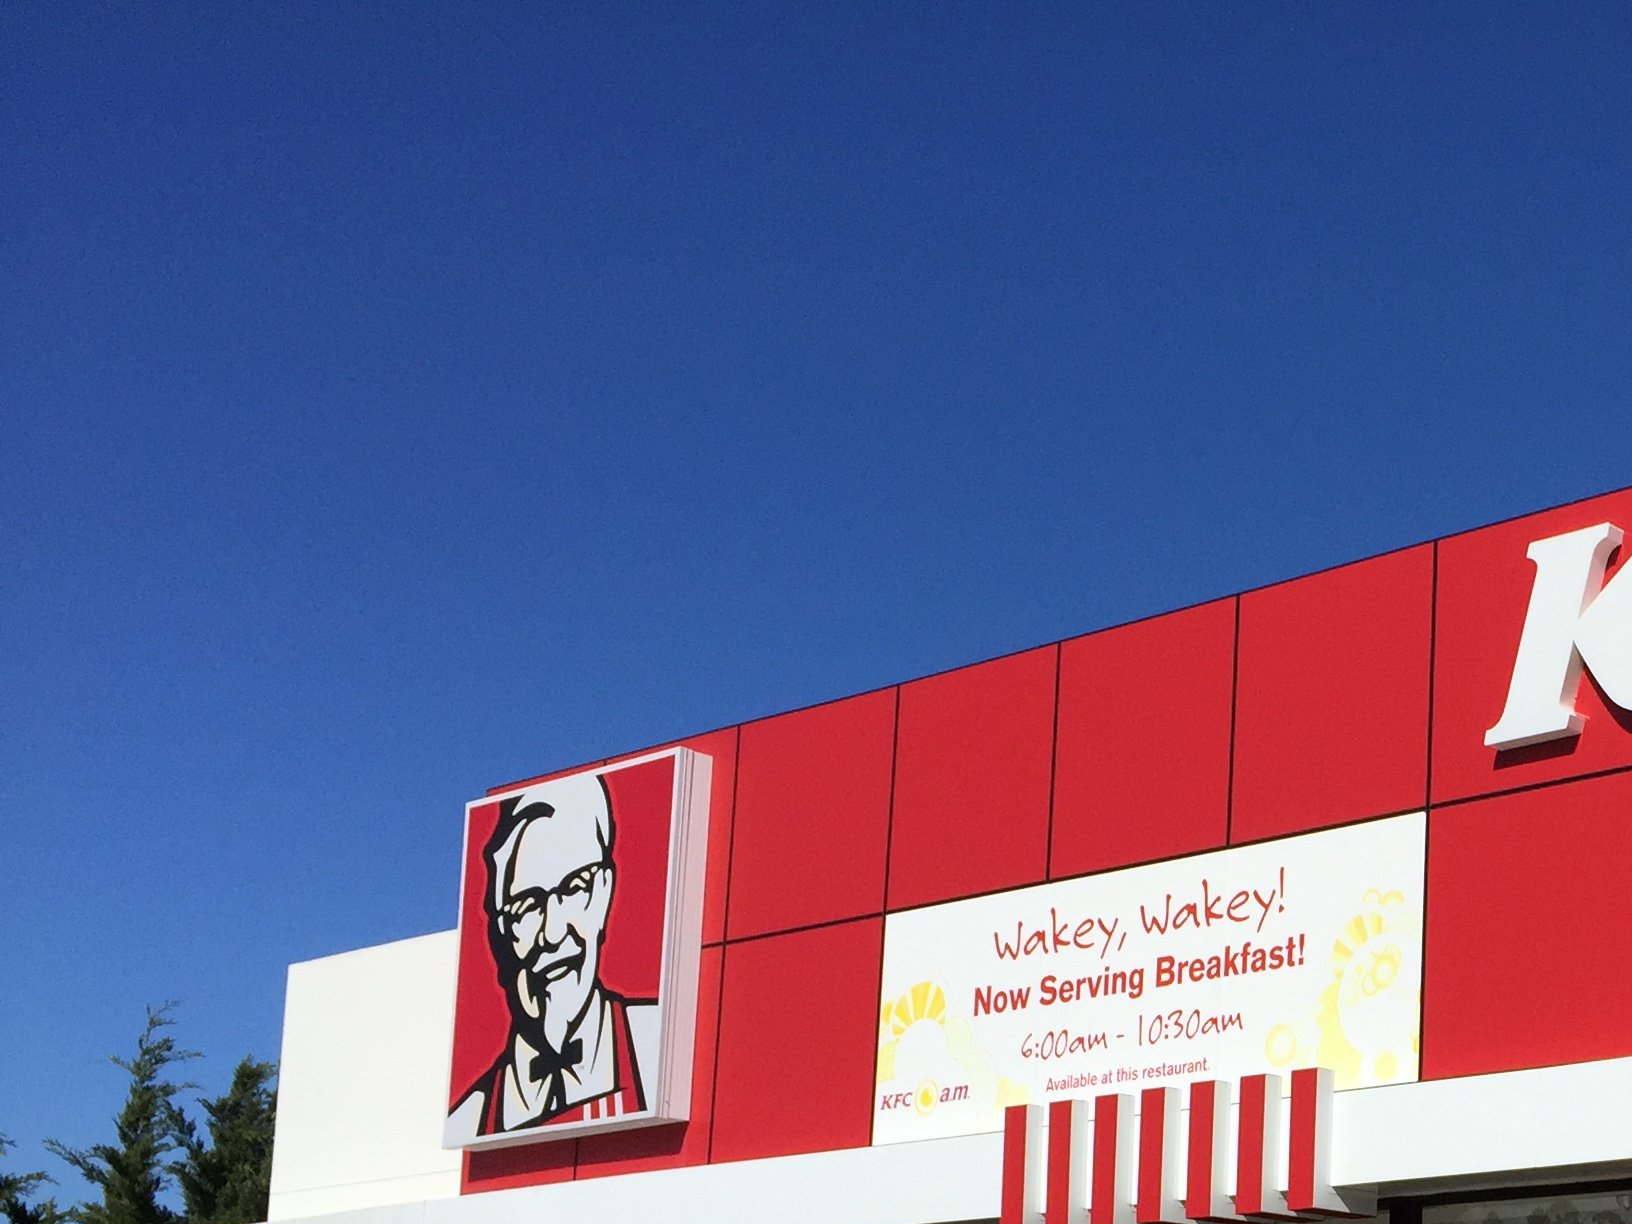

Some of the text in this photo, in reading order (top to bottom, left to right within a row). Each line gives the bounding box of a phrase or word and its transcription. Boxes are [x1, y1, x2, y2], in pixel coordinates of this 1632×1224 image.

[994, 867, 1284, 959] Wakey, Wakey!
[973, 934, 1305, 1016] Now Serving Breakfast!
[1021, 1030, 1108, 1060] 6:00am
[1139, 1009, 1243, 1046] 10:30am
[880, 1092, 913, 1110] KFC
[1046, 1073, 1097, 1092] Available
[1101, 1071, 1113, 1084] at
[1117, 1067, 1138, 1082] this
